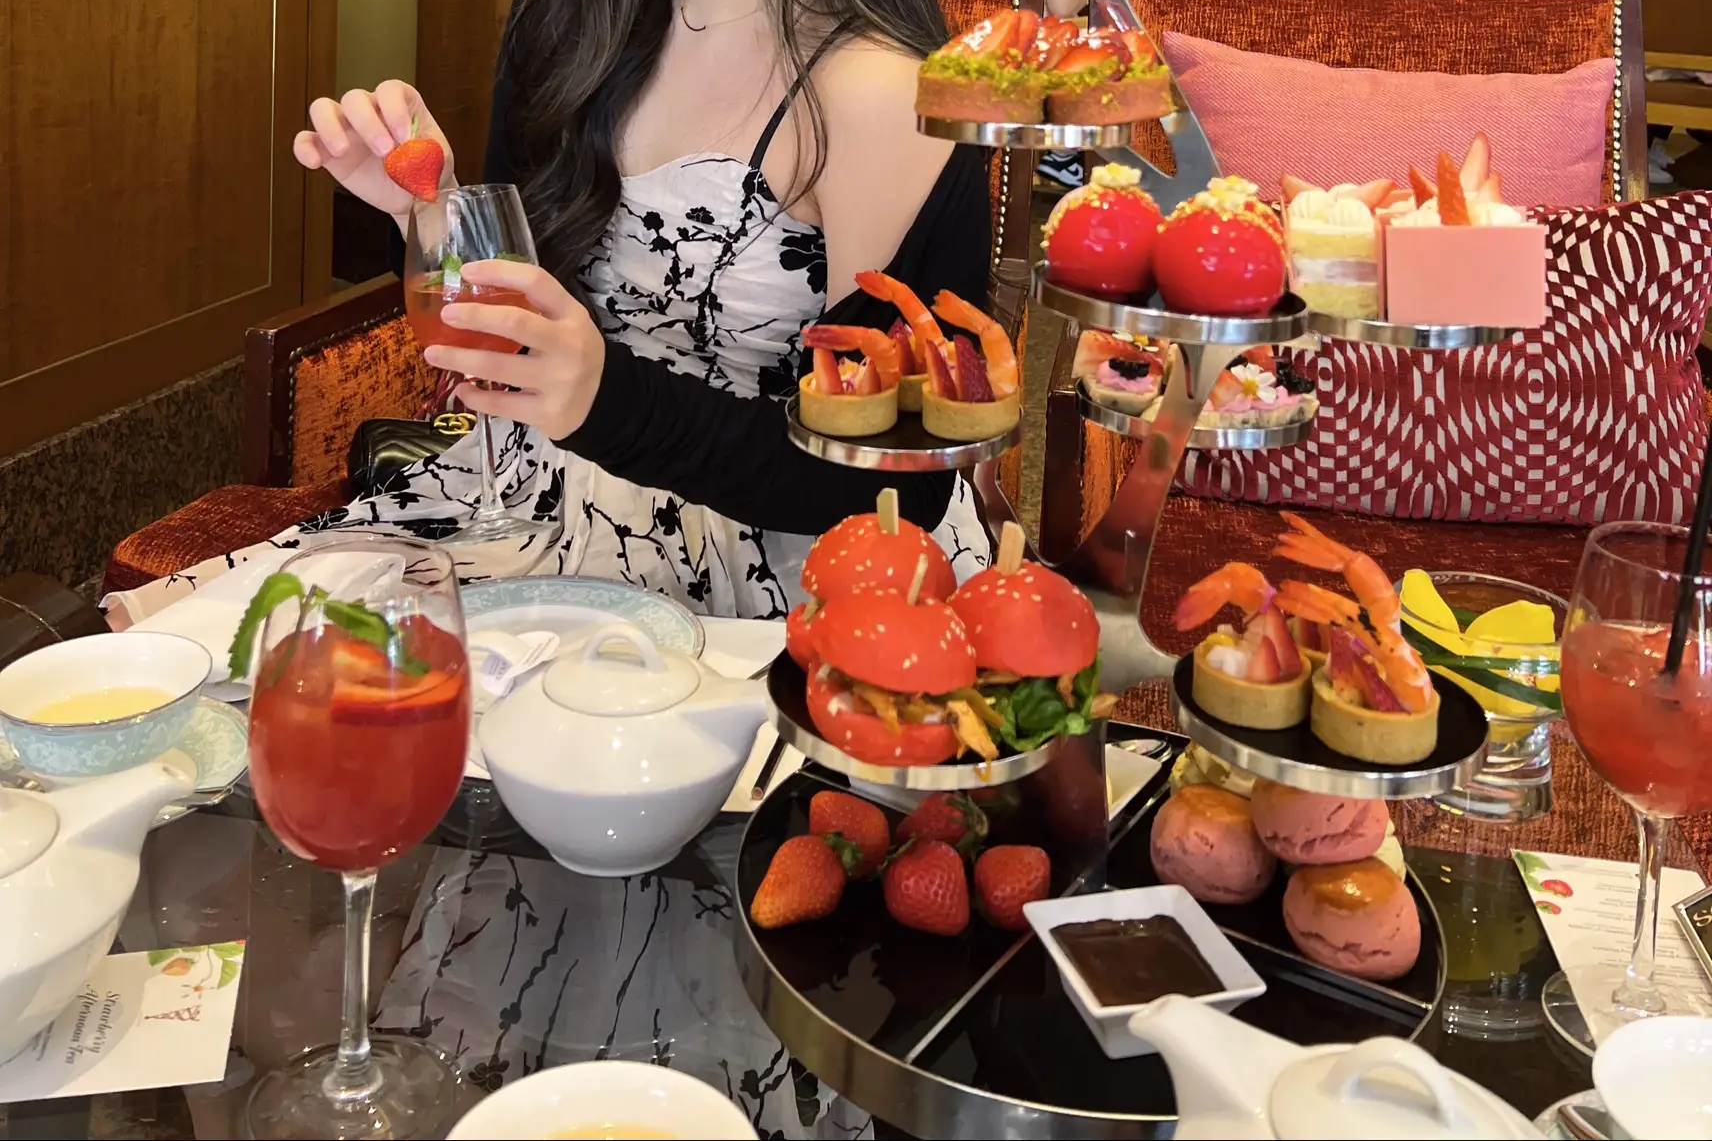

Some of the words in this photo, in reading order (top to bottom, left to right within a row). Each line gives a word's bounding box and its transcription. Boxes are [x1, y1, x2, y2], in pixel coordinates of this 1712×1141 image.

[70, 983, 99, 1043] Afternoon
[84, 990, 121, 1054] Strawberry
[65, 1044, 83, 1064] Tea
